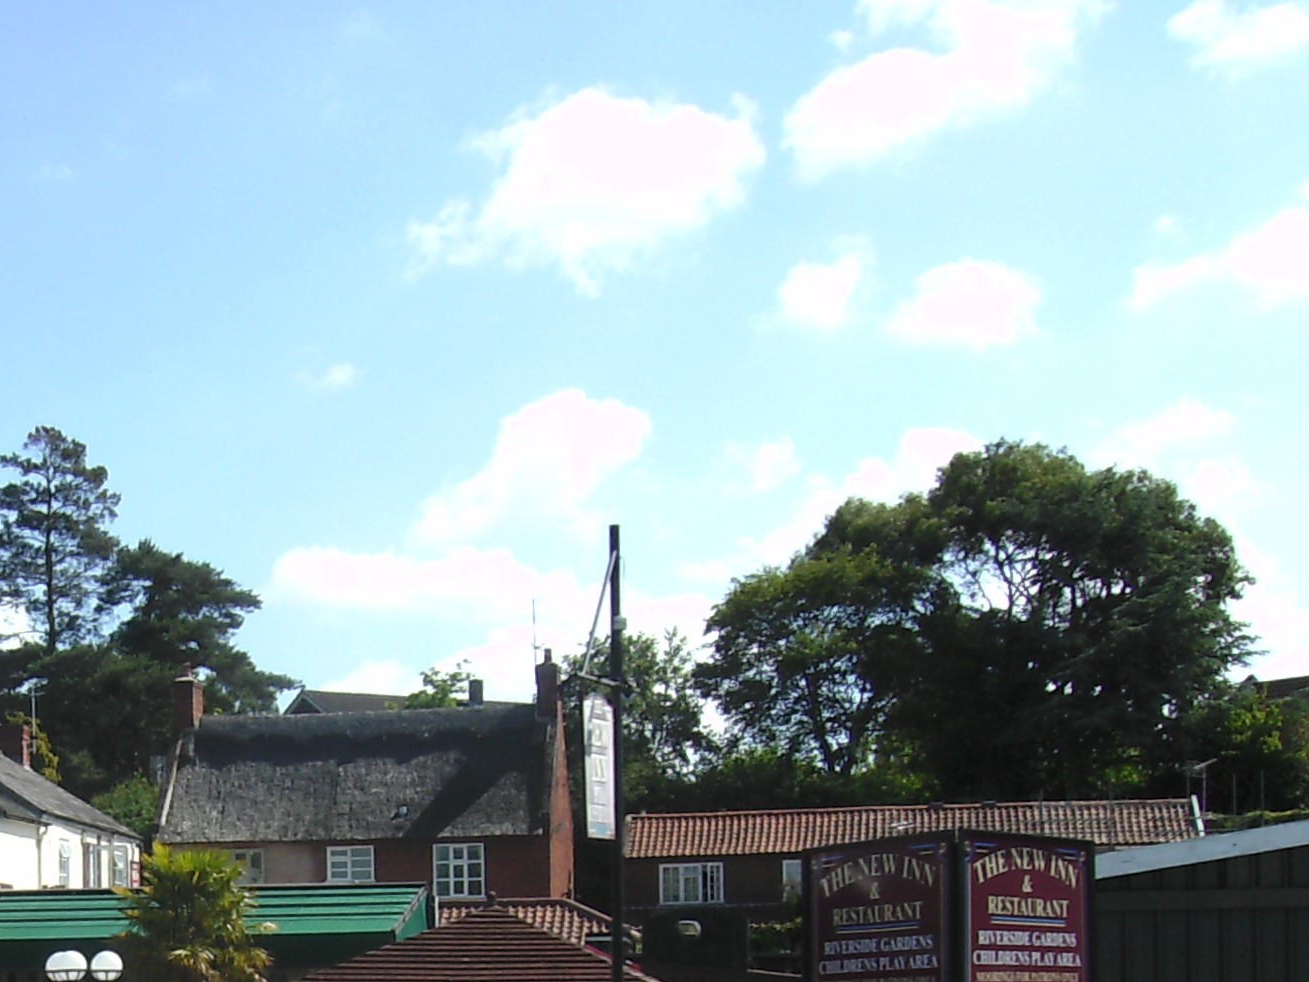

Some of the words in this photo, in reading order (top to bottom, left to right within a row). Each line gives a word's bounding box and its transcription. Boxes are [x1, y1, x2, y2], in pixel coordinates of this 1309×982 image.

[820, 862, 854, 897] THE
[858, 853, 898, 880] NEW
[902, 856, 937, 887] INN
[973, 849, 1009, 884] THE
[1011, 847, 1048, 872] NEW
[1049, 854, 1079, 888] INN
[869, 881, 880, 900] &
[1022, 874, 1033, 893] &
[833, 901, 923, 926] RESTAURANT
[988, 895, 1069, 918] RESTAURANT
[824, 937, 879, 955] RIVERSIDE
[880, 934, 933, 951] GARDENS
[978, 930, 1032, 946] RIVERSIDE
[1032, 932, 1077, 947] GARDENS
[819, 958, 878, 975] CHILDRENS
[879, 956, 909, 971] PLAY
[909, 954, 938, 969] AREA
[973, 950, 1030, 966] CHILDRENS
[1031, 952, 1056, 967] PLAY
[1056, 952, 1081, 967] AREA
